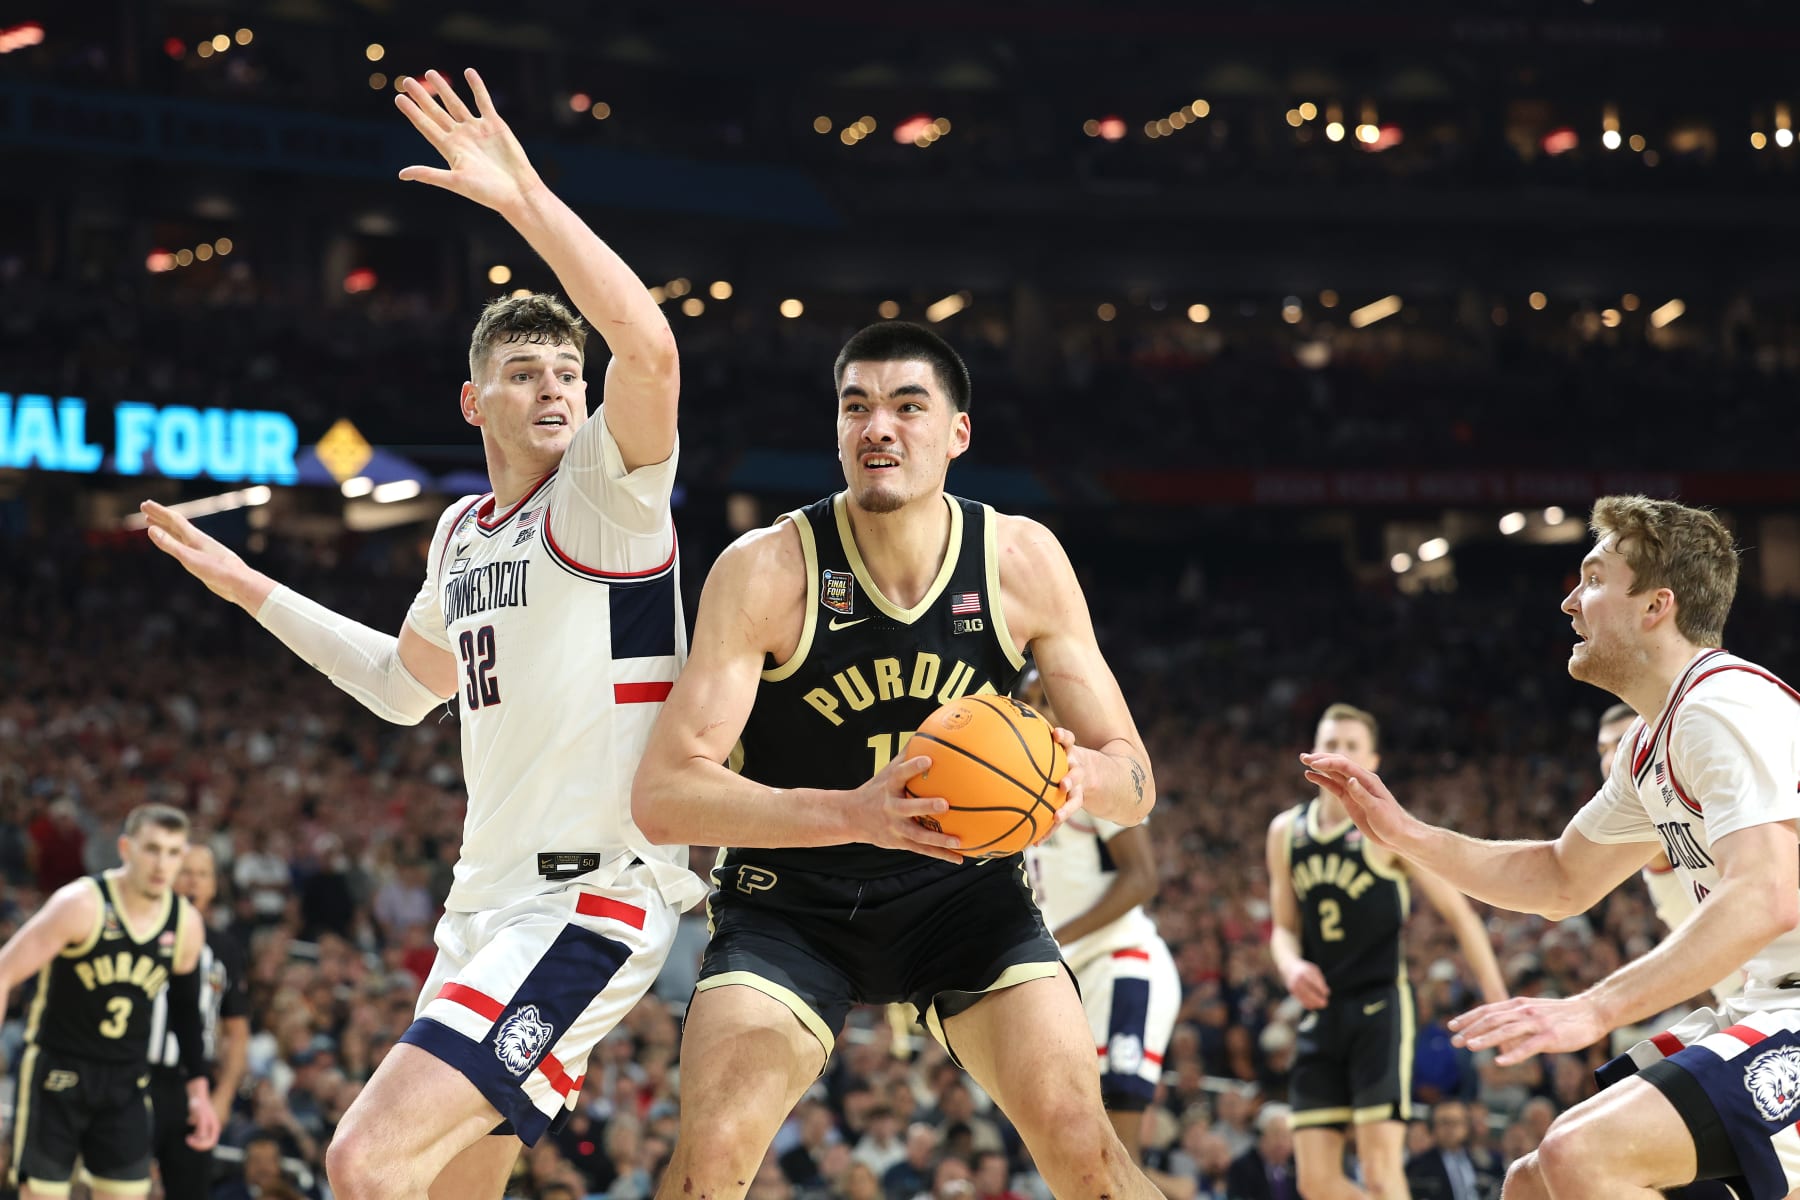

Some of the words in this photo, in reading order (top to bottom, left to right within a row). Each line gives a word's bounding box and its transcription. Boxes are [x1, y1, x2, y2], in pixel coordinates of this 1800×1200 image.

[114, 401, 299, 486] FOUR
[444, 559, 530, 631] CONNECTICUT
[827, 579, 847, 588] FINAL
[827, 588, 846, 597] FOUR
[459, 624, 501, 711] 32
[803, 651, 1000, 726] PURDU
[583, 858, 594, 867] 50
[736, 864, 778, 895] P
[1318, 899, 1344, 941] 2
[74, 951, 169, 1000] PURDU
[99, 995, 133, 1039] 3
